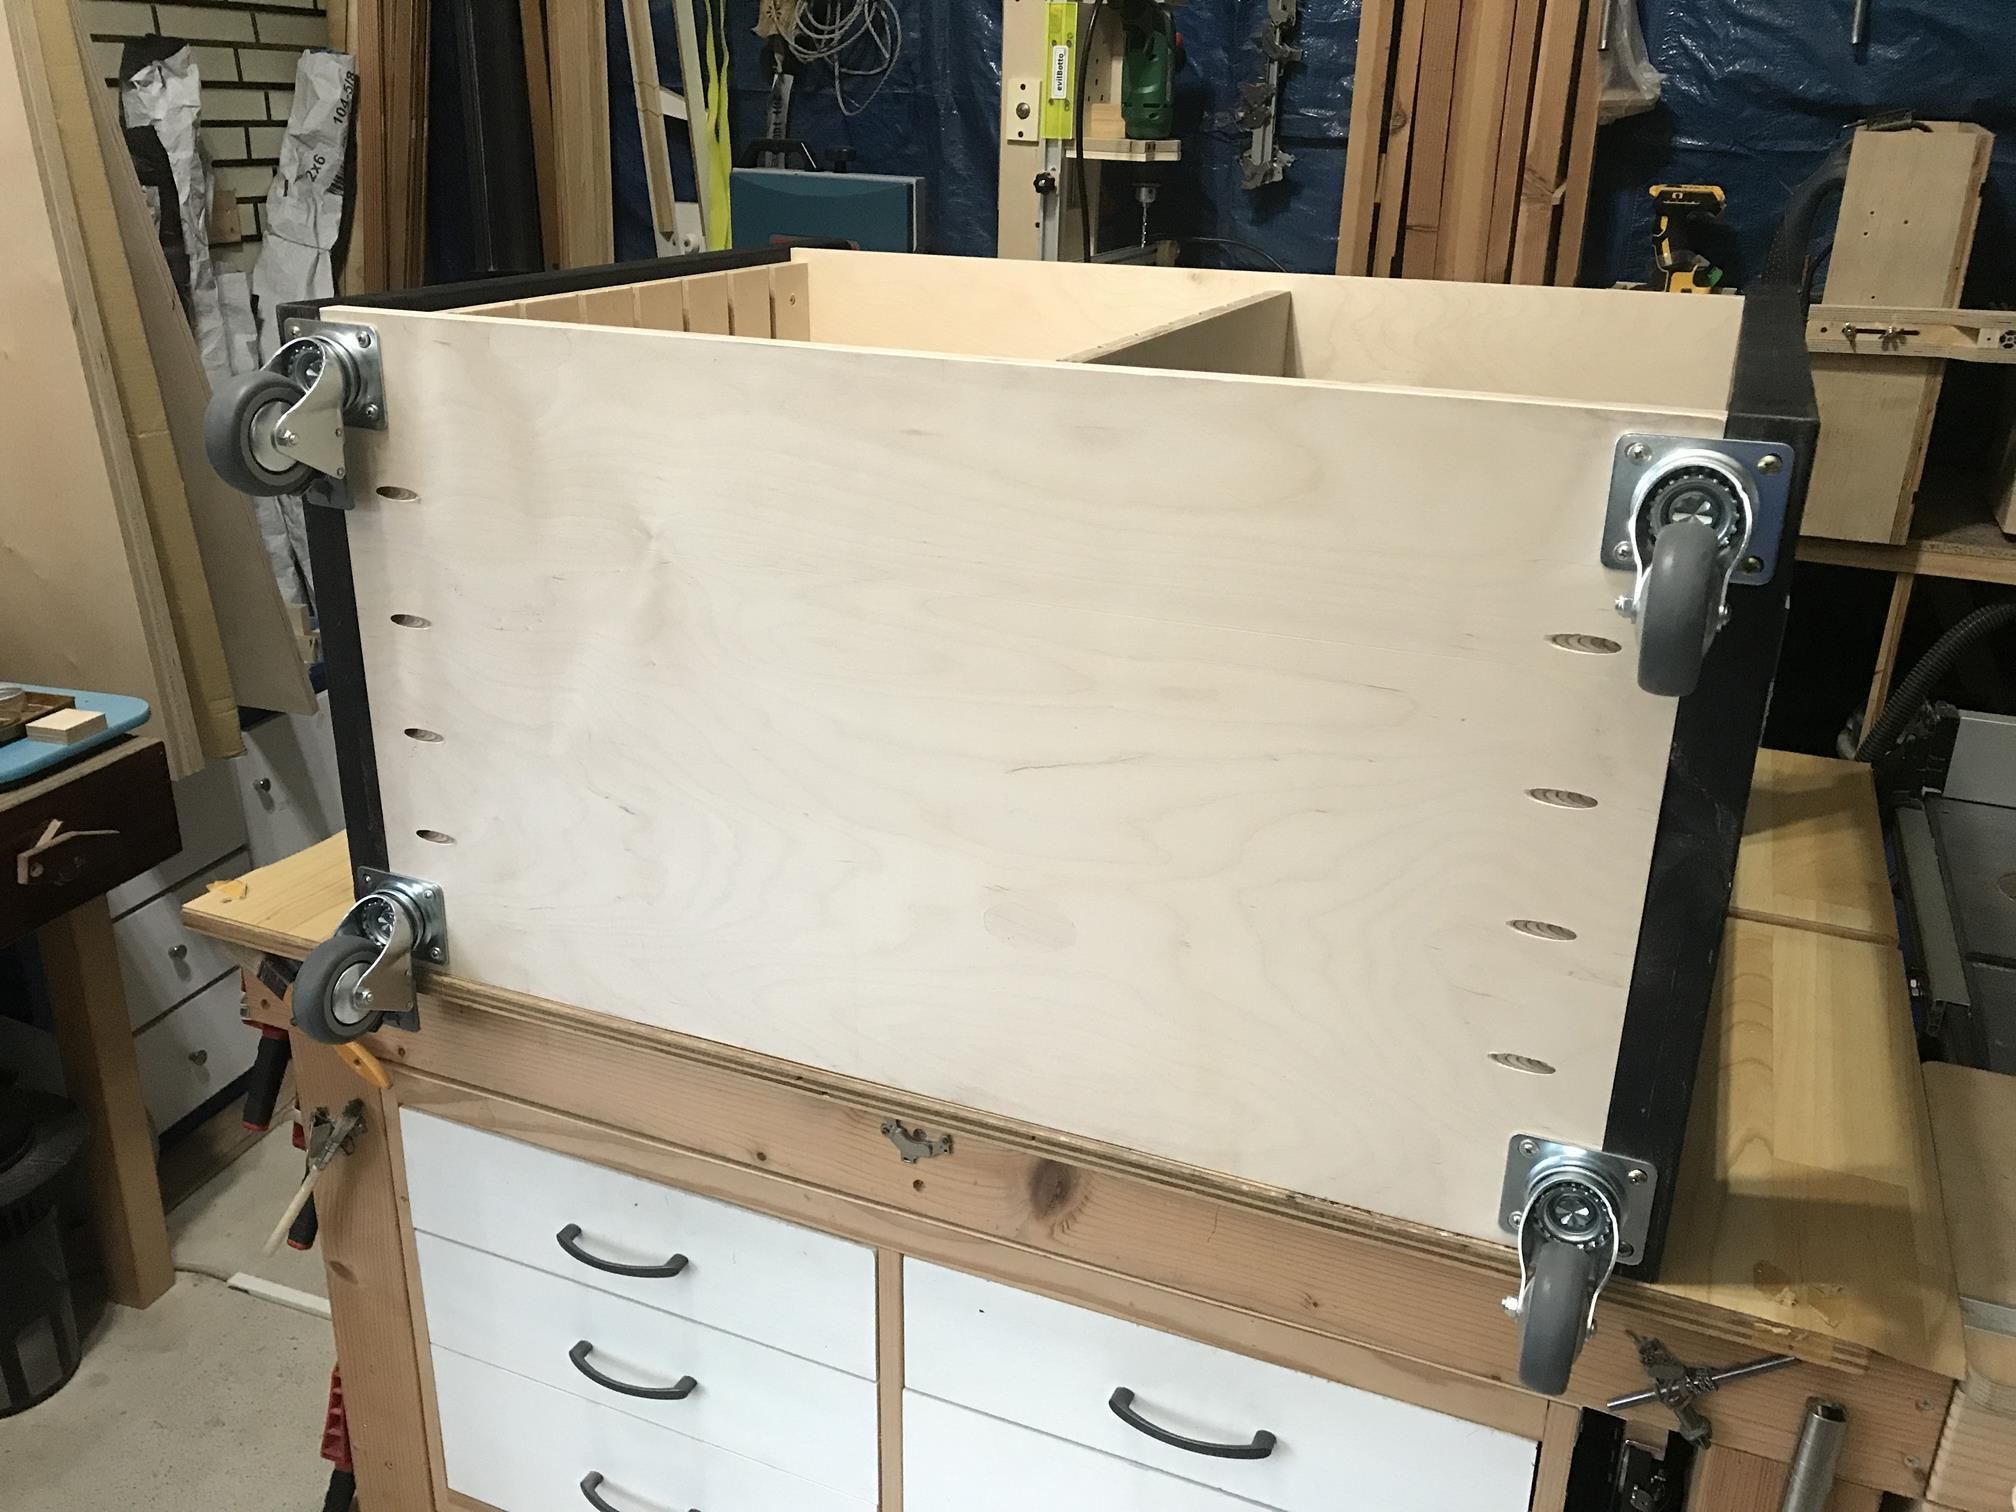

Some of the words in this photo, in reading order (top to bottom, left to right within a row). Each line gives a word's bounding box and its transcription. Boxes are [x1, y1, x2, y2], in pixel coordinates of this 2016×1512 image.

[1055, 53, 1064, 92] evilBotto
[333, 70, 355, 125] 104-5/8
[305, 154, 326, 183] 2x6
